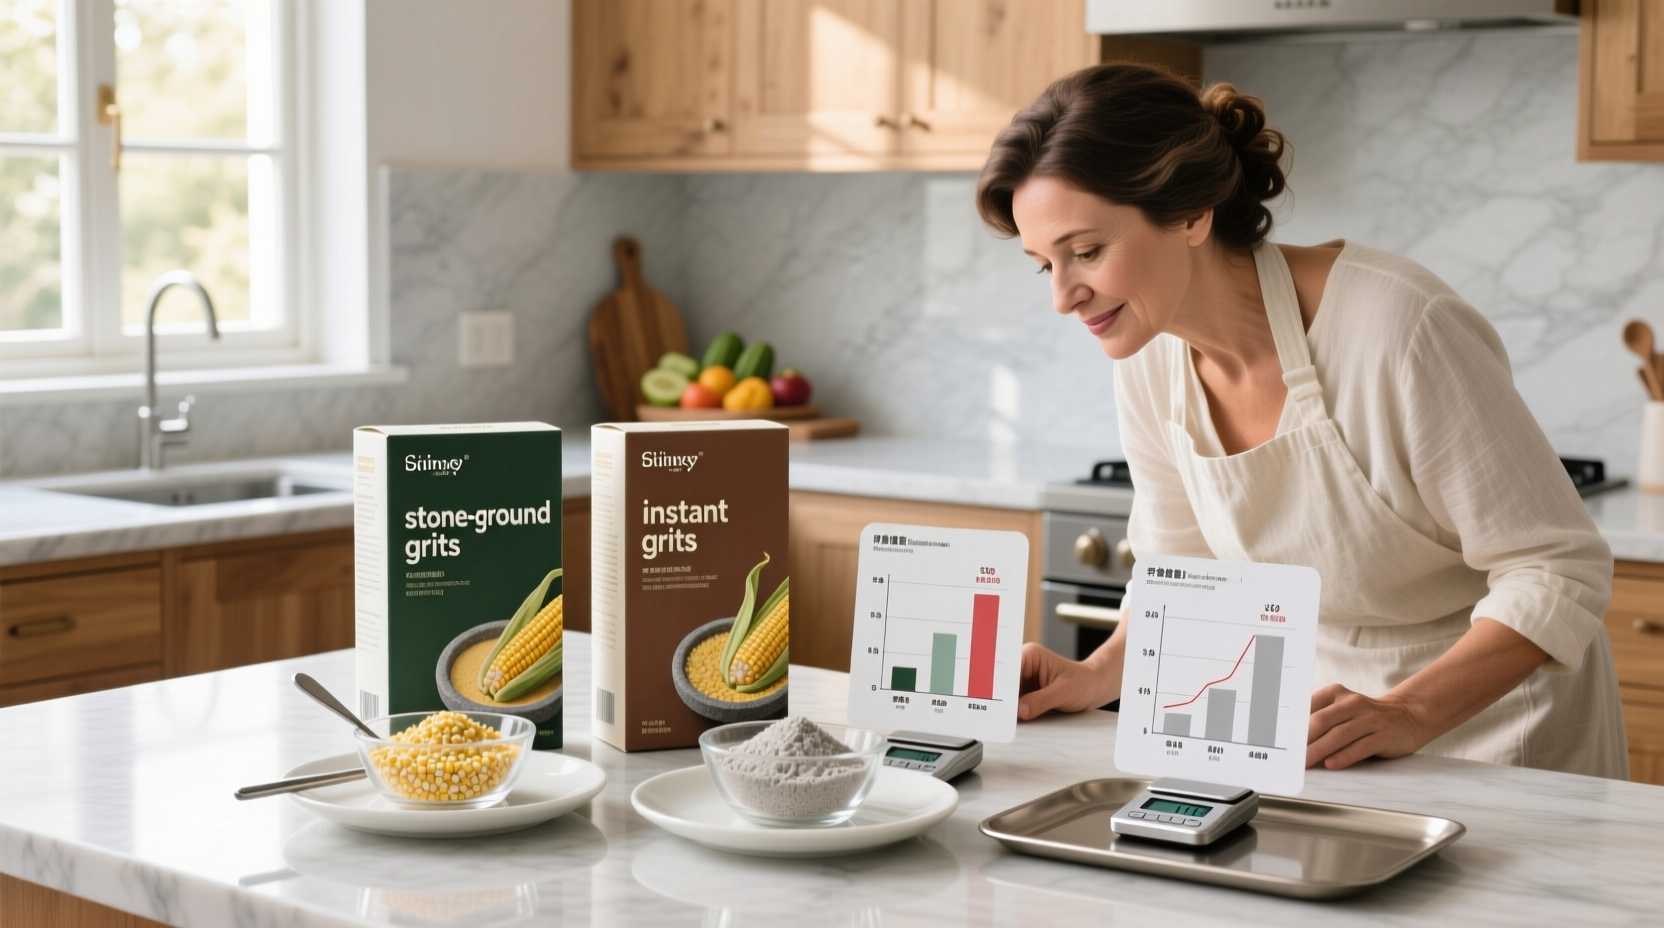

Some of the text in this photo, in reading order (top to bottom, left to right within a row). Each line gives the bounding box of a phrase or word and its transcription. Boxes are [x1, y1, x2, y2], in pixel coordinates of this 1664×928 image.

[404, 499, 551, 534] stone-ground
[642, 499, 729, 525] instant
[404, 532, 461, 565] grits
[641, 527, 698, 560] grits
